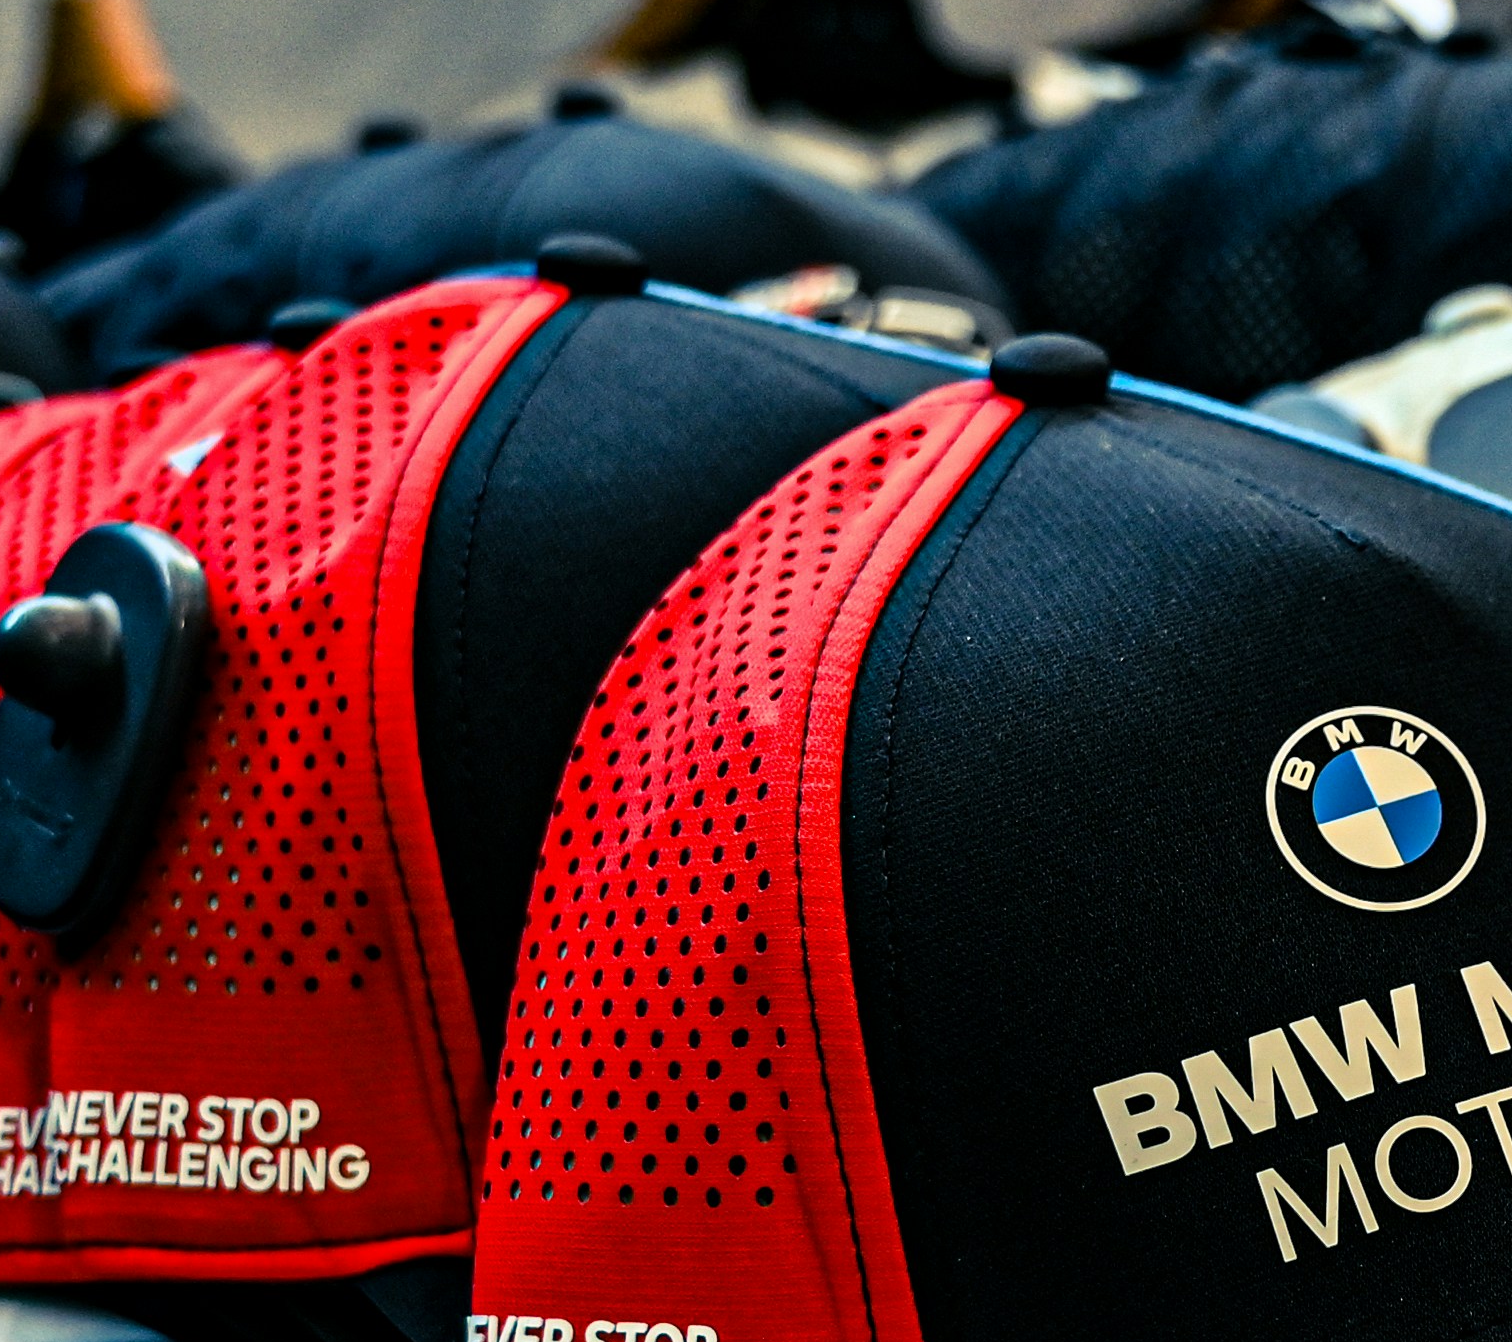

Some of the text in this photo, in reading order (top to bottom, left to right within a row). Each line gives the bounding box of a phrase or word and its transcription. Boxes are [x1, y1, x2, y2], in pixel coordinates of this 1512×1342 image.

[1282, 718, 1428, 792] BMW
[1093, 983, 1428, 1177] BMW
[48, 1090, 322, 1147] NEVER STOP
[53, 1135, 372, 1194] CHALLENGING
